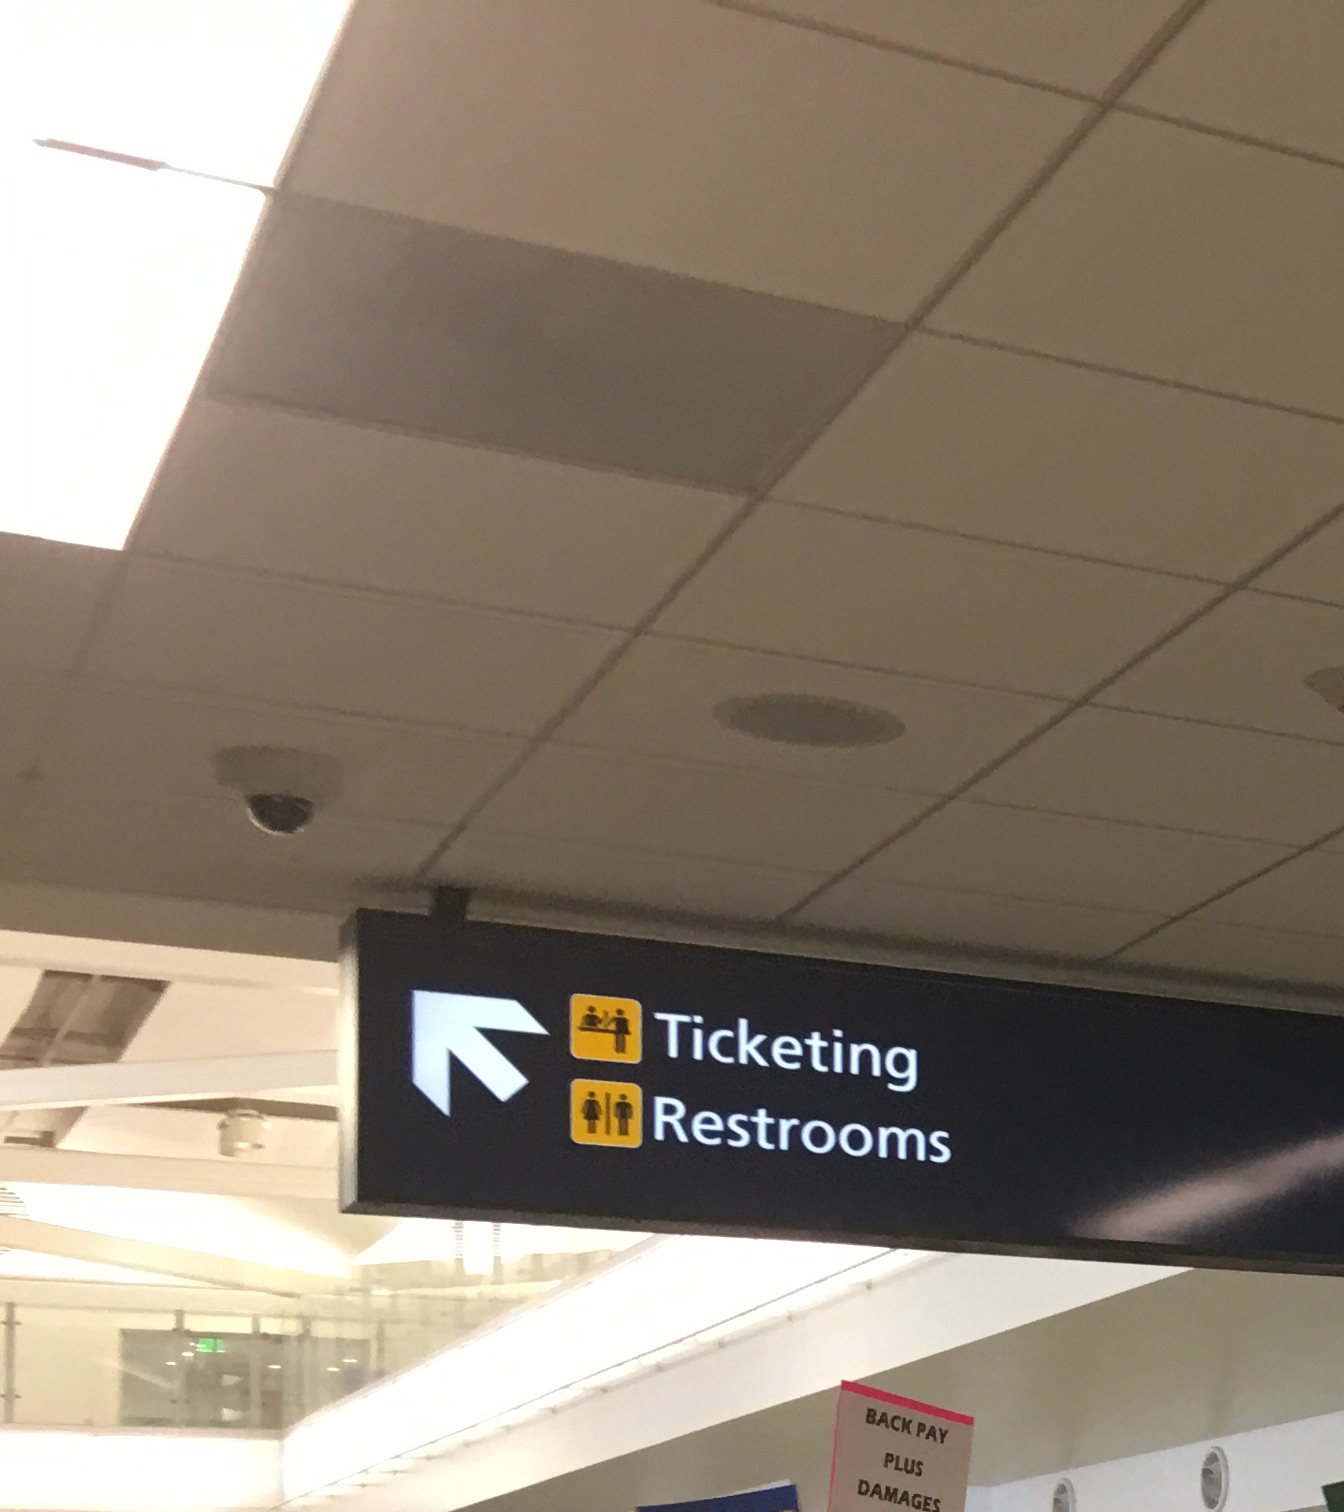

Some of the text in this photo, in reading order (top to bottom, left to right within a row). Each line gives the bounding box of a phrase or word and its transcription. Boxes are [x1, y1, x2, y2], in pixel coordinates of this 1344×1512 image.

[653, 1011, 919, 1092] Ticketing
[653, 1096, 952, 1164] Restrooms
[865, 1407, 950, 1444] BACK PAY
[883, 1452, 924, 1477] PLUS
